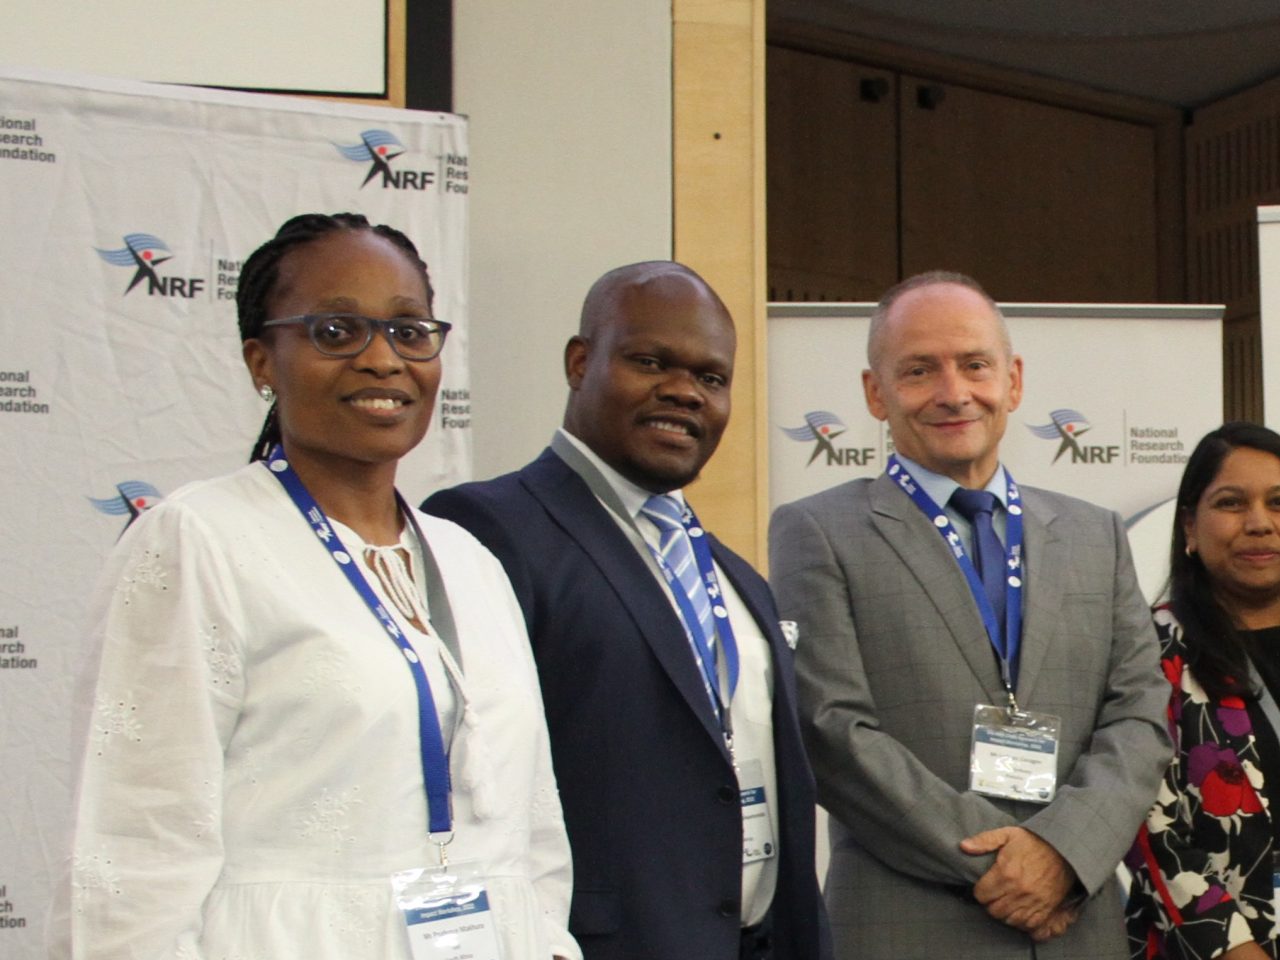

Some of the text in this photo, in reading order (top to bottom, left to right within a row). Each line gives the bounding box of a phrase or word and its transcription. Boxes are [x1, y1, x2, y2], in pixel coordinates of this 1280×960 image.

[0, 116, 36, 131] ional
[0, 134, 43, 146] earch
[0, 148, 56, 163] ndation
[383, 170, 435, 191] NRF
[149, 277, 204, 298] NRF
[1130, 427, 1178, 438] National
[1130, 440, 1184, 451] Research
[827, 448, 876, 467] NRF
[1072, 446, 1120, 464] NRF
[1130, 452, 1190, 464] Foundatio
